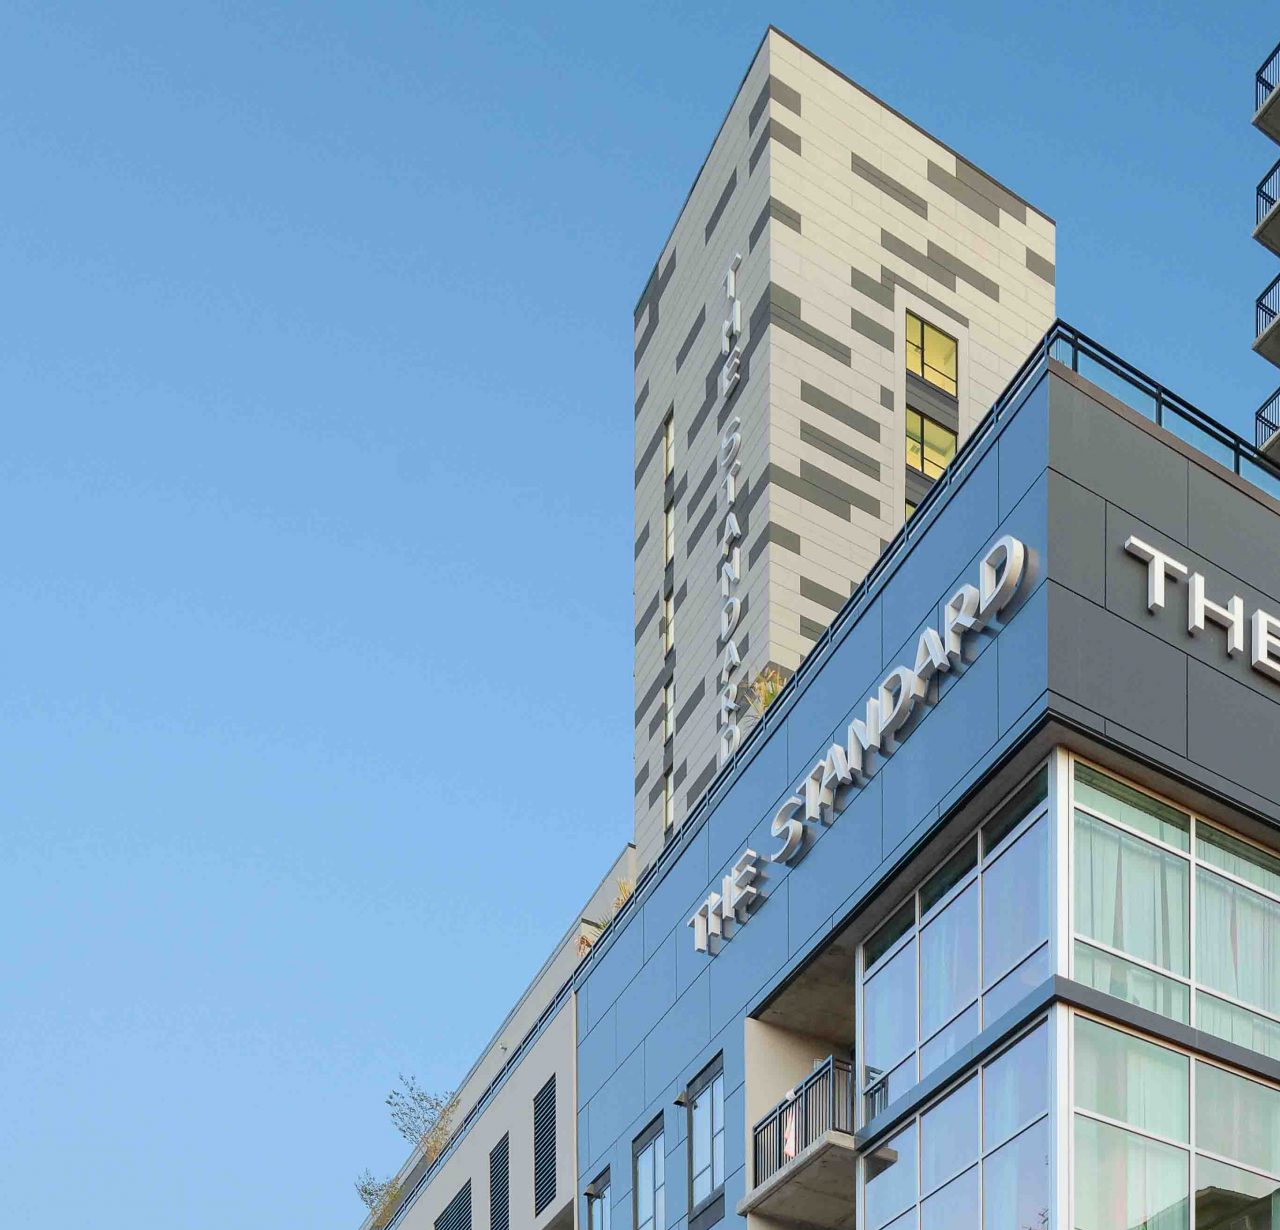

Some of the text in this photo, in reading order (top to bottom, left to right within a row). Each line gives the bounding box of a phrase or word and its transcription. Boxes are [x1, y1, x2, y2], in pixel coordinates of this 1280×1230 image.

[720, 251, 742, 767] THE STANDARD
[687, 534, 1028, 955] THE STANDARD
